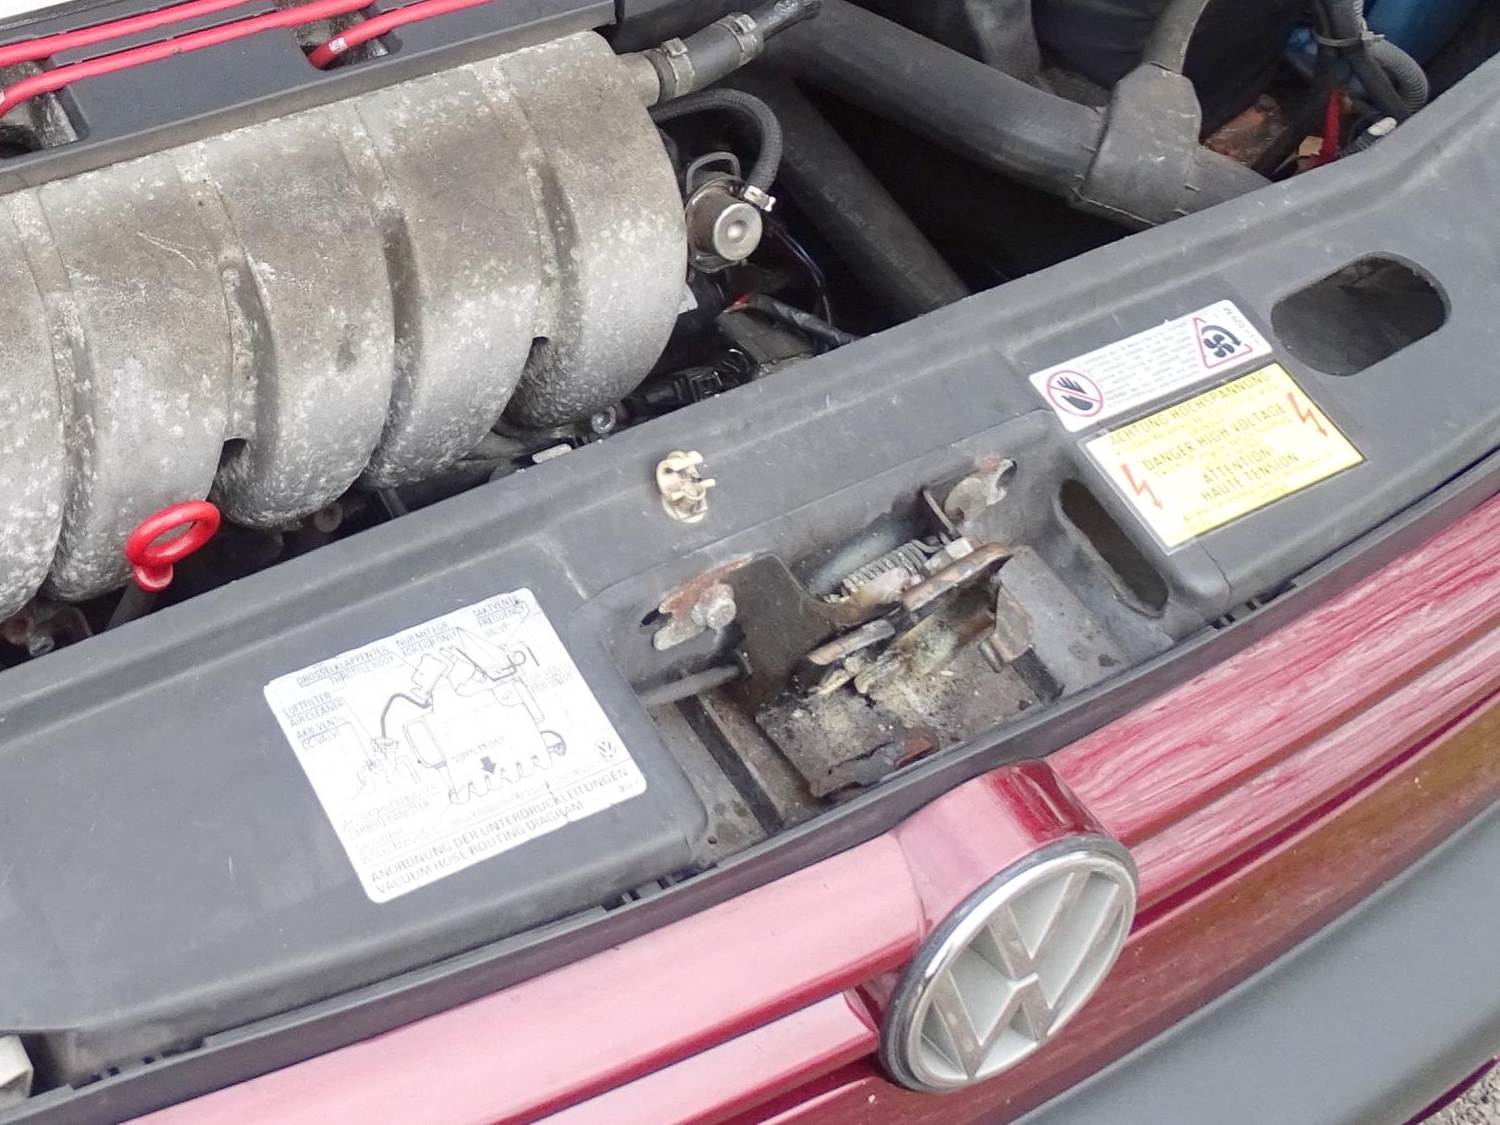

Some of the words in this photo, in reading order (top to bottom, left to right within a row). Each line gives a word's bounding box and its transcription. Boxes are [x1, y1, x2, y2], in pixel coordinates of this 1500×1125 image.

[1105, 412, 1170, 446] ACHTUNG
[1166, 369, 1273, 420] HOCHSPANNUNG
[1140, 439, 1197, 471] DANGER
[1193, 425, 1231, 448] HIGH
[1227, 401, 1287, 433] VOLTAGE
[1198, 475, 1245, 502] HAUTE
[1242, 450, 1301, 482] TENSION
[476, 601, 526, 629] FREQUENCY
[482, 621, 511, 639] VALVE
[394, 633, 417, 648] NUR
[413, 627, 432, 641] MIT
[430, 620, 450, 634] EGR
[400, 643, 420, 658] FOR
[416, 636, 438, 652] EGR
[434, 628, 459, 645] ONLY
[294, 641, 389, 687] DROSSELKLAPPENTEIL
[328, 662, 372, 686] THROTTLE
[370, 652, 396, 670] BODY
[529, 680, 549, 696] EGR
[546, 670, 575, 689] VALVE
[281, 689, 332, 718] LUFTFILTER
[287, 714, 306, 728] AIR
[303, 697, 346, 722] CLEANER
[346, 815, 388, 841] CARBON
[385, 797, 432, 826] CANISTER
[367, 837, 453, 885] ANORDNUNG
[451, 828, 480, 848] DER
[477, 761, 629, 841] UNTERDRUCKLEITUNGEN
[374, 861, 433, 896] VACUUM
[431, 847, 469, 872] HOSE
[466, 822, 526, 857] ROUTING
[524, 797, 585, 833] DIAGRAM
